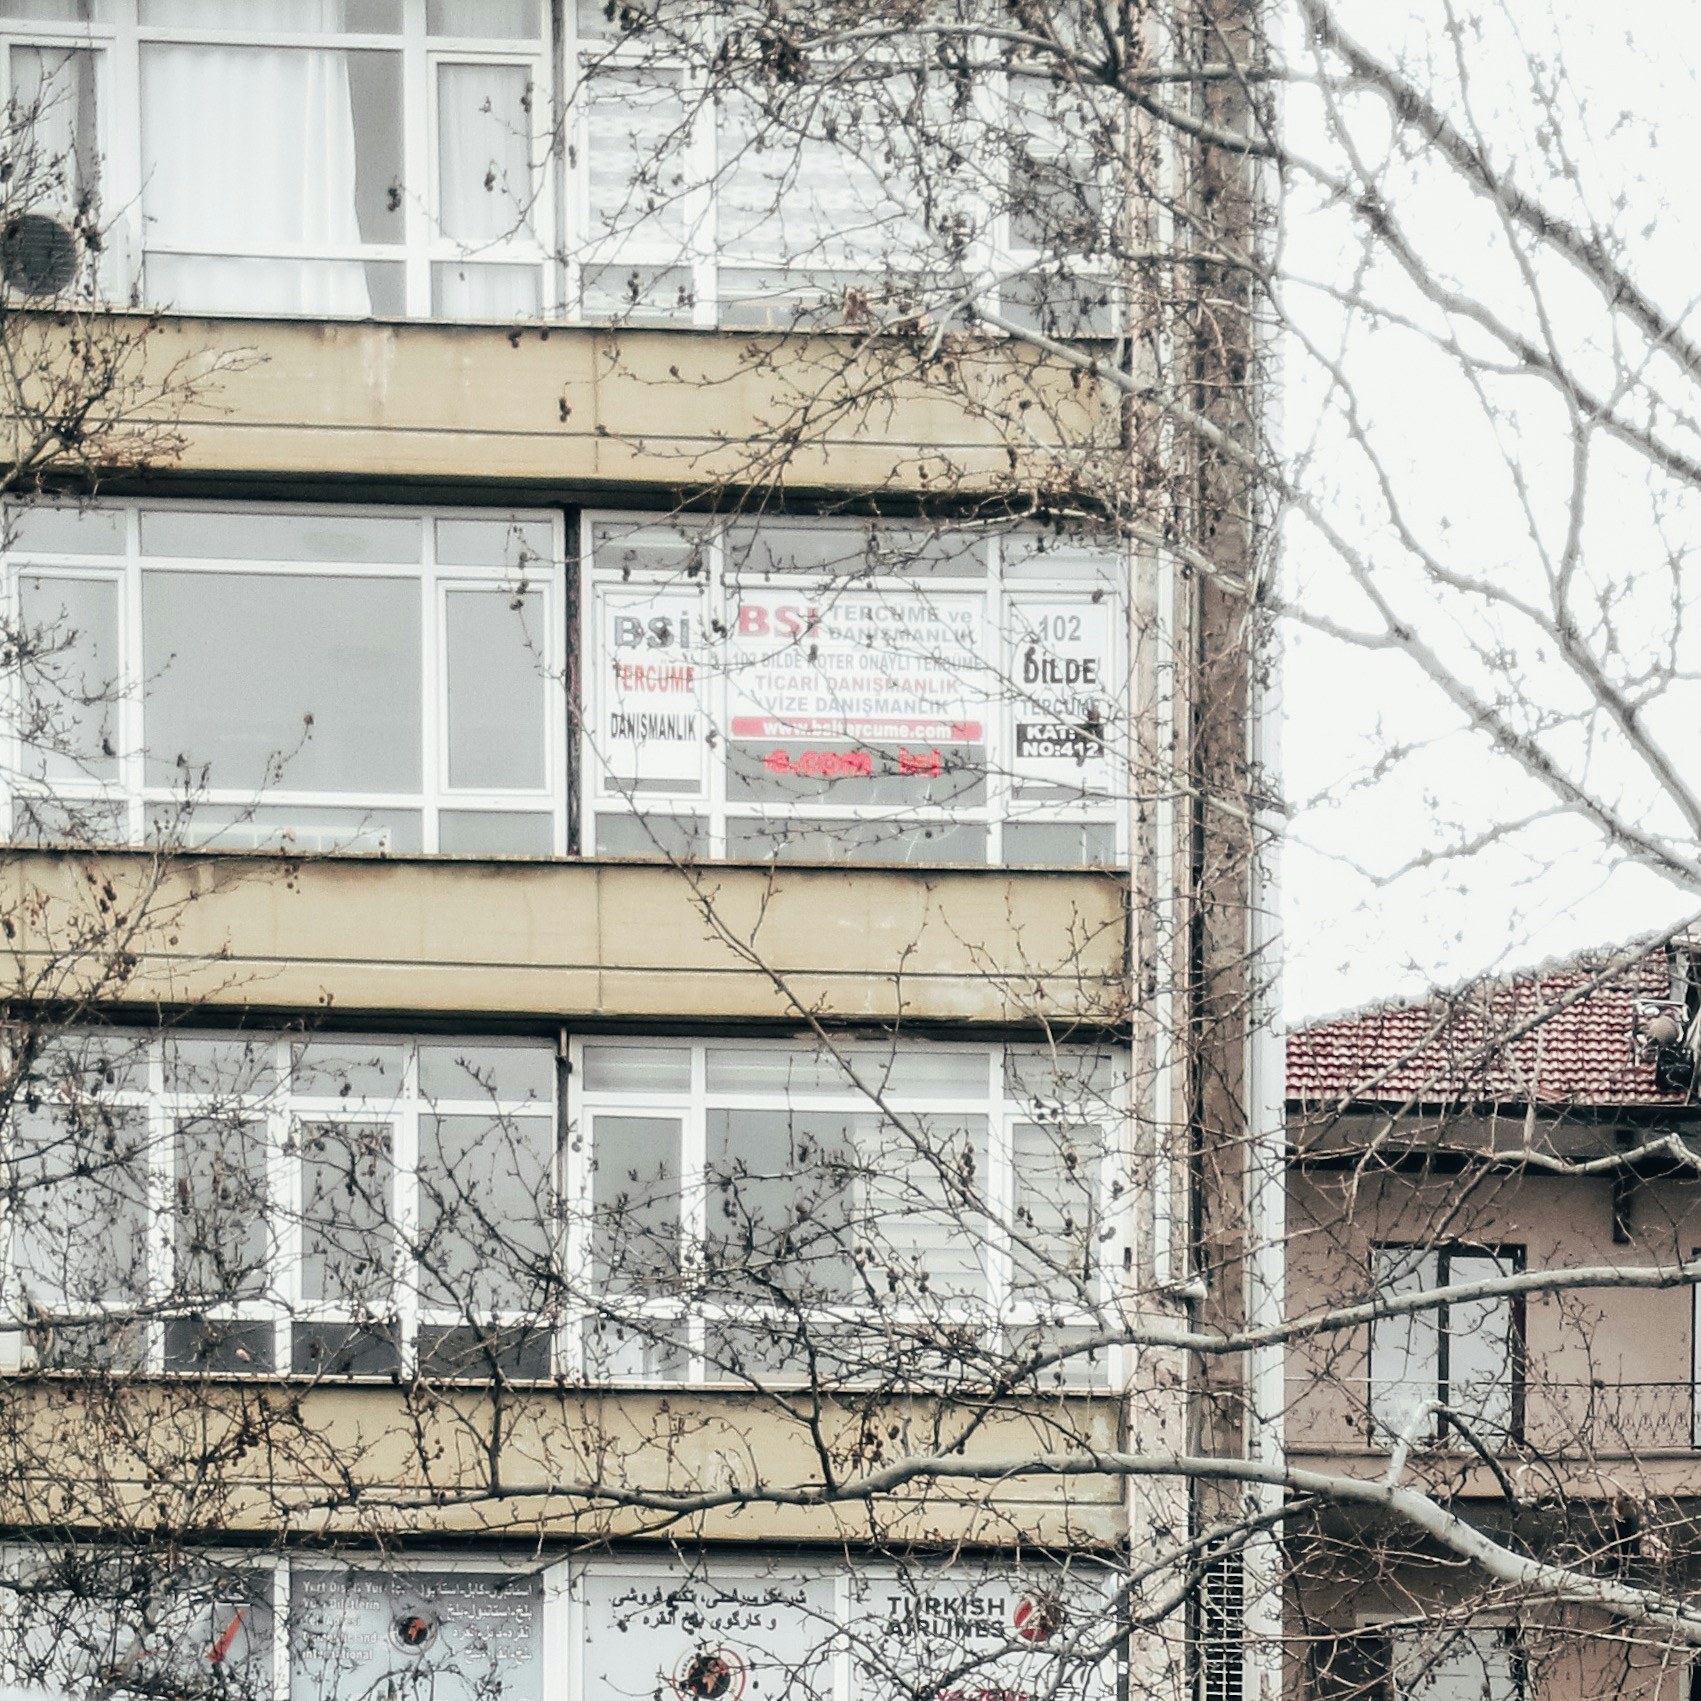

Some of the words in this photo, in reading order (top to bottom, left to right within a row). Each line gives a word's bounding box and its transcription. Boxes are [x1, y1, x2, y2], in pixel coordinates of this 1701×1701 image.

[948, 610, 972, 623] ve
[614, 611, 690, 648] BSİ
[1039, 615, 1081, 641] 102
[756, 673, 819, 692] TİCARİ
[767, 694, 808, 712] VİZE
[816, 695, 949, 716] DANIŞMANLIK
[1022, 742, 1099, 757] NO:412
[887, 1597, 1005, 1616] TURKISH
